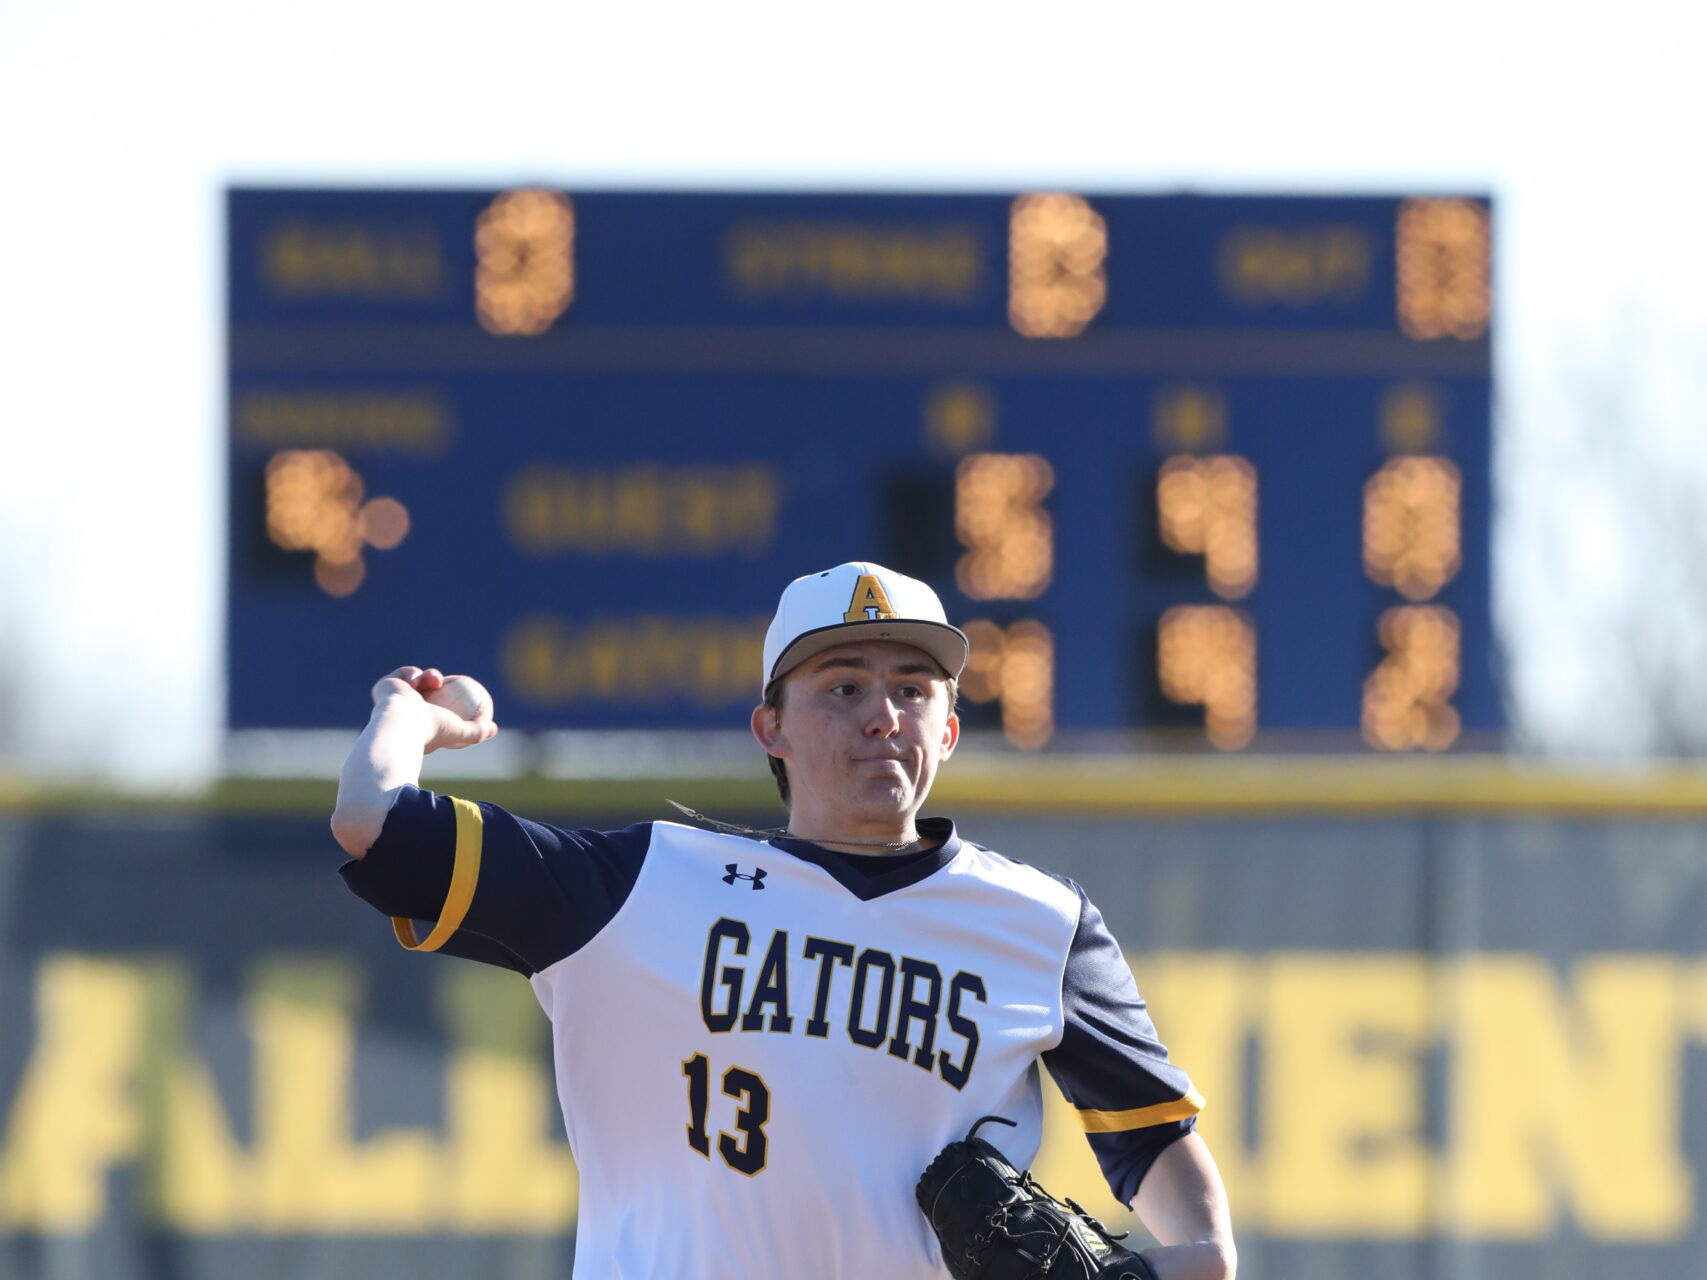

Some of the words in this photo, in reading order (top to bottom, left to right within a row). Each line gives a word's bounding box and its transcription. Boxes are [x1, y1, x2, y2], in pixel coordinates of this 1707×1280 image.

[843, 574, 899, 624] A
[506, 614, 770, 706] GATOR
[700, 916, 988, 1092] GATORS
[681, 1051, 771, 1178] 13
